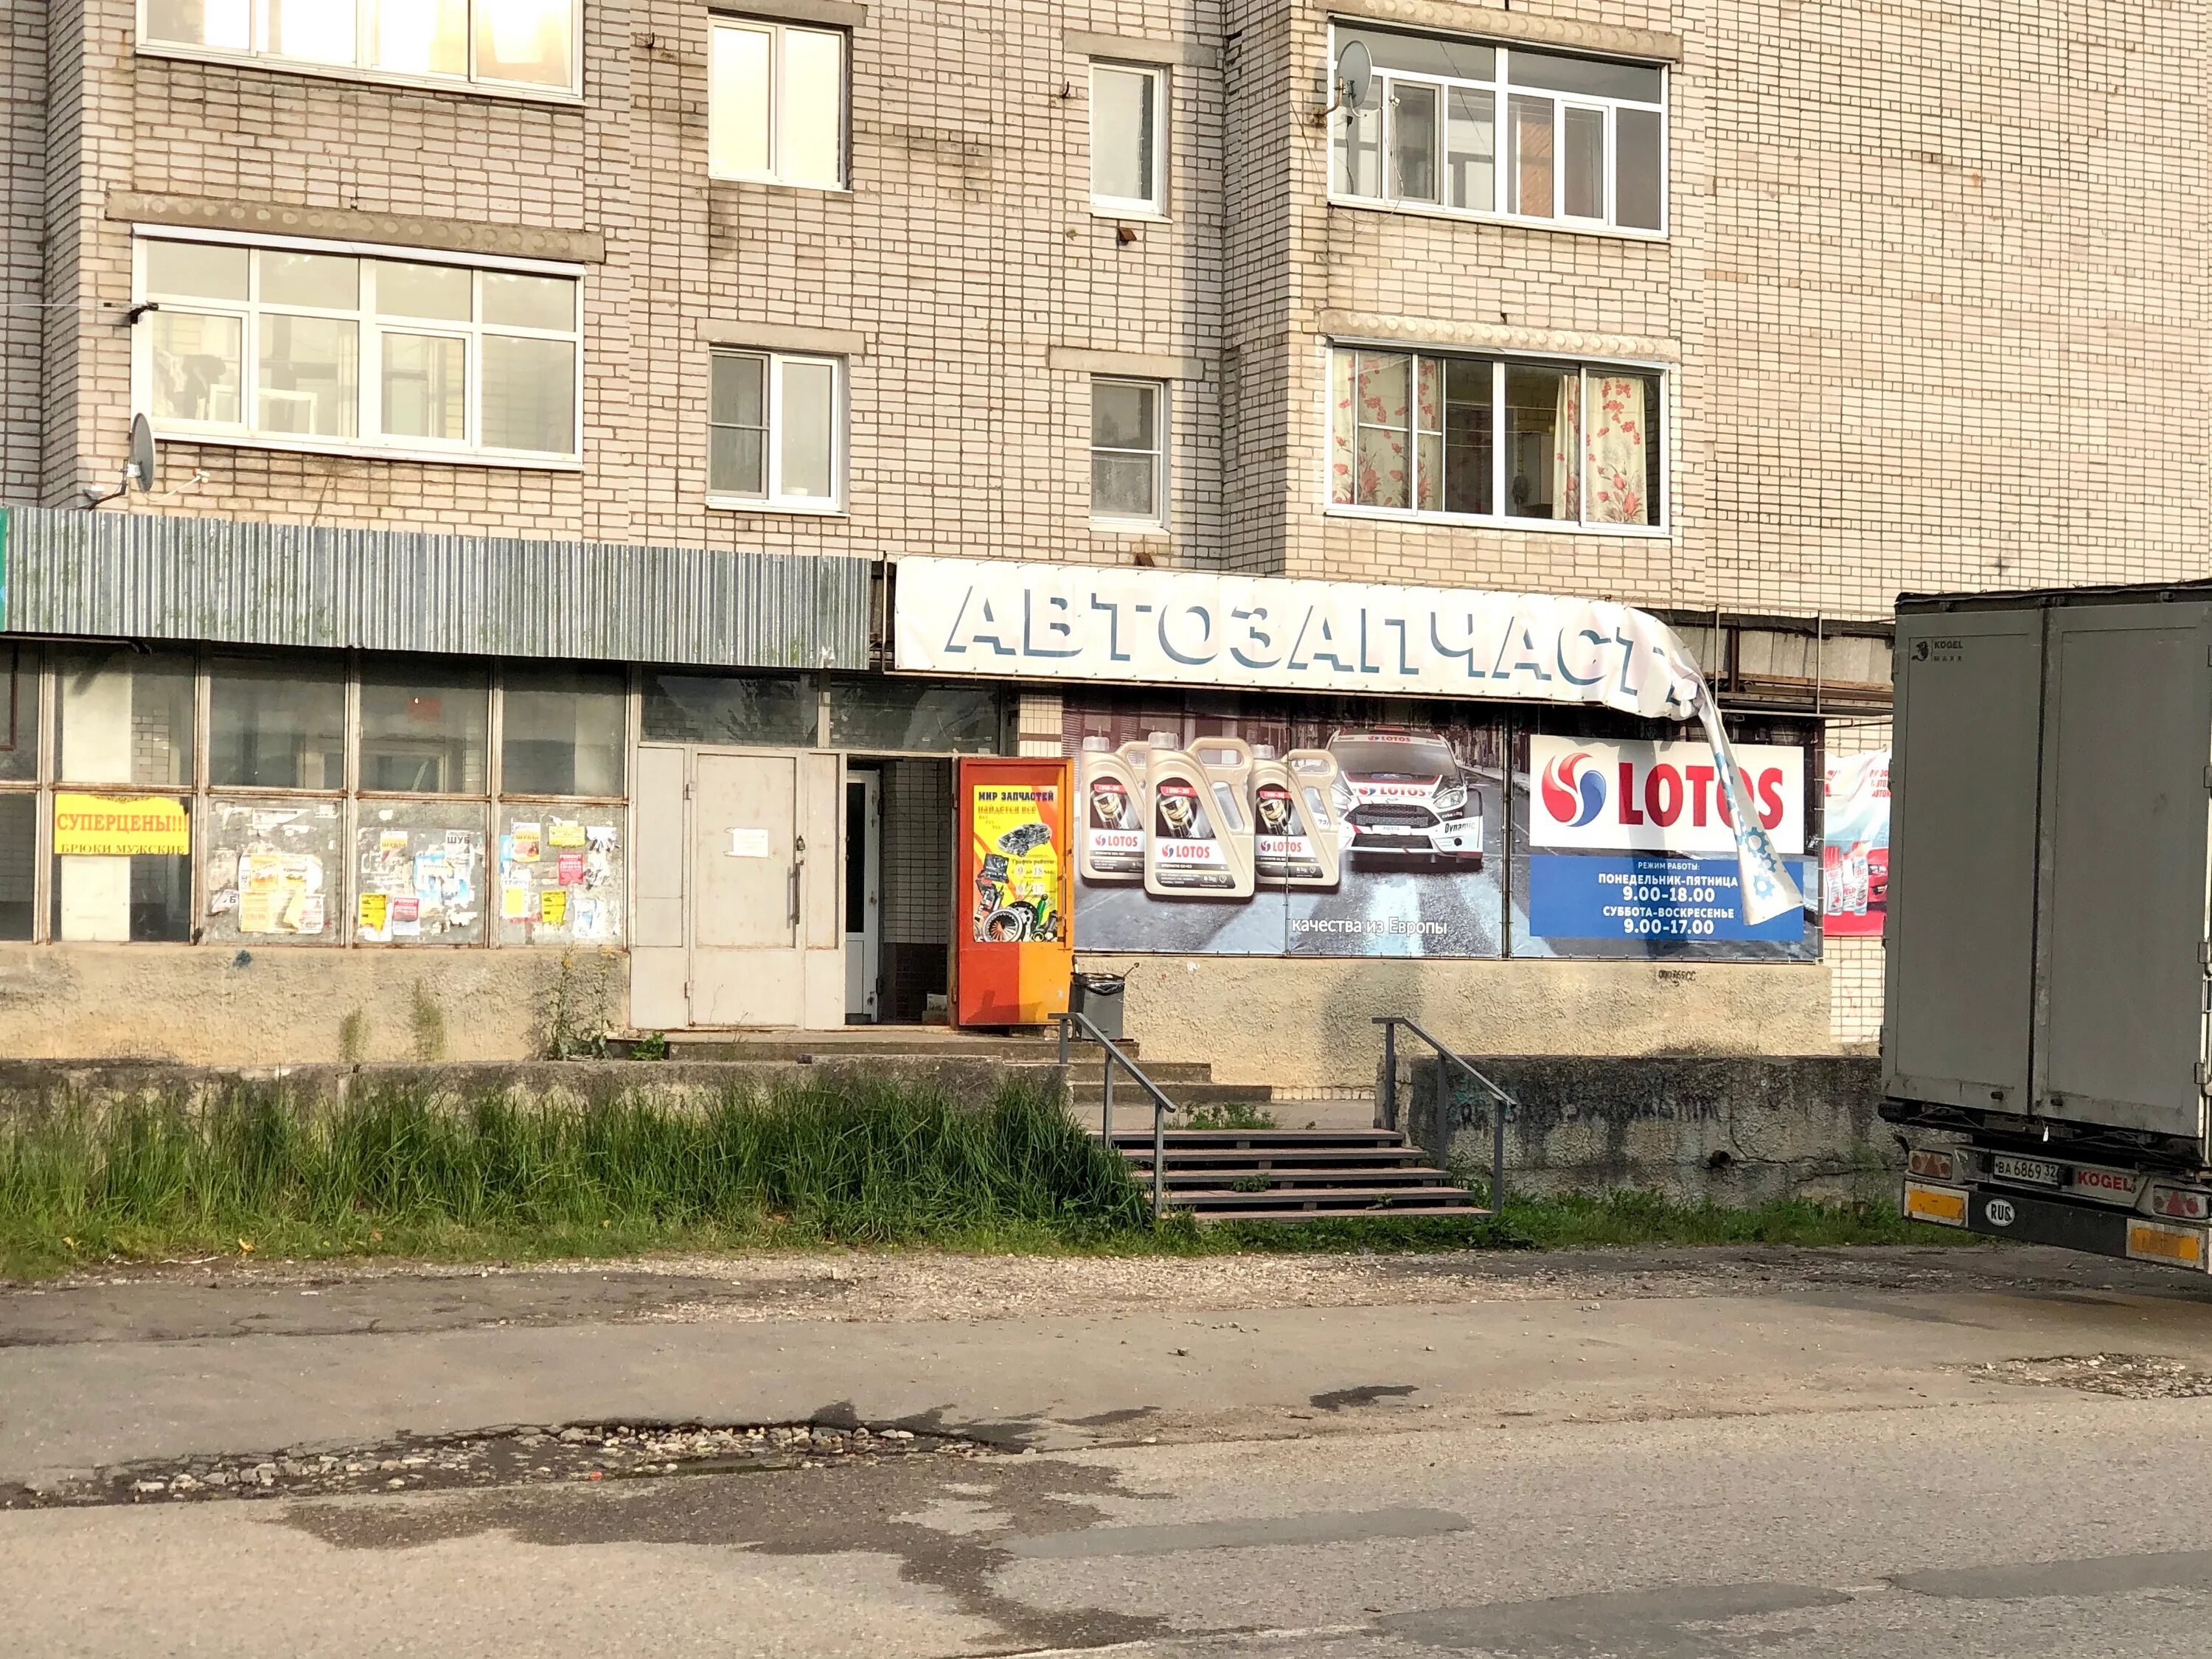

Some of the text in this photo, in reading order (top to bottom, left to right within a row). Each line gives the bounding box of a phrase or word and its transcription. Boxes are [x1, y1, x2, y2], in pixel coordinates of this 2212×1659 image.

[978, 790, 1054, 802] МИР ЗАПЧАСТЕЙ
[1380, 786, 1426, 797] LOTOS
[56, 813, 188, 833] СУПЕРЦЕНЫ!!!
[447, 836, 470, 844] ШУБ
[1107, 835, 1138, 847] LOTOS
[61, 844, 185, 855] БРЮКИ МУЖСКИЕ
[1175, 846, 1210, 858] LOTOS
[1273, 841, 1302, 853] LOTOS
[1018, 866, 1023, 875] 9
[1034, 867, 1043, 875] 18
[1637, 861, 1700, 871] РЕЖИМ РАБОТЫ:
[1598, 873, 1739, 888] ПОНЕДЕЛЬНИК-ПЯТНИЦА
[1622, 886, 1716, 903] 9.00-18.00
[1602, 905, 1735, 919] СУББОТА-ВОСКРЕСЕНЬЕ
[1292, 919, 1448, 939] качества из Европы
[1624, 919, 1715, 935] 9.00-17.00
[2014, 1161, 2042, 1180] 6869
[2044, 1164, 2056, 1178] 32
[1990, 1203, 2011, 1221] RUS
